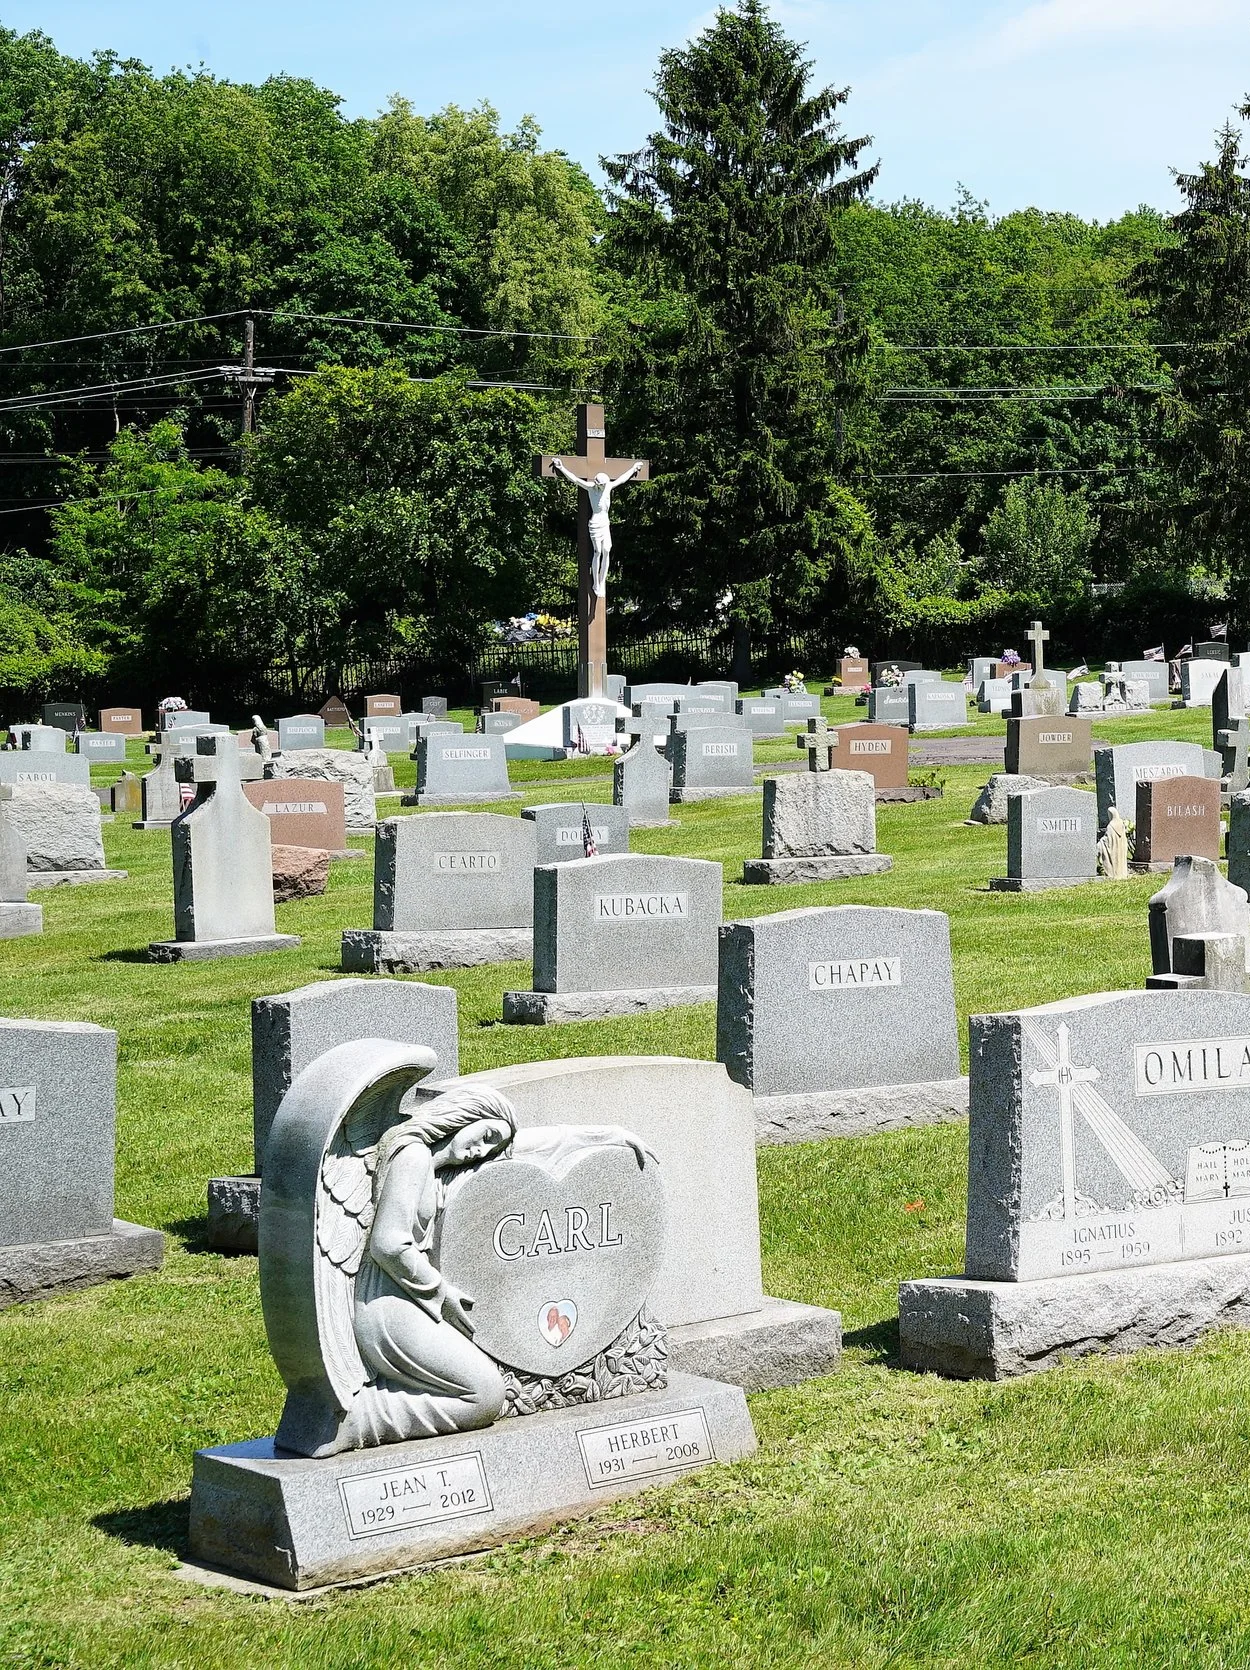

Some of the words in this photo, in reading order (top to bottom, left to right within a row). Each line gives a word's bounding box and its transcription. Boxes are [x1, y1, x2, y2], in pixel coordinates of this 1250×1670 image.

[444, 749, 489, 759] SELFINGER
[704, 744, 736, 754] BERISH
[854, 742, 887, 752] HYDEN
[18, 772, 54, 782] SABOL
[274, 803, 314, 813] LAZUR
[1041, 819, 1078, 832] SMITH
[438, 855, 497, 869] CEARTO
[599, 896, 684, 917] KUBACKA
[814, 961, 895, 986] CHAPAY
[1197, 1160, 1217, 1169] HAIL
[1195, 1173, 1220, 1182] MARY
[492, 1202, 623, 1261] CARL
[1073, 1222, 1136, 1244] IGNATIUS
[1214, 1229, 1243, 1247] 1892
[1061, 1249, 1091, 1266] 1895
[1121, 1241, 1150, 1259] 1959
[607, 1423, 681, 1454] HERBERT
[598, 1457, 626, 1476] 1931
[665, 1442, 701, 1462] 2008
[379, 1475, 428, 1502] JEAN
[437, 1470, 453, 1489] T.
[361, 1505, 396, 1526] 1929
[440, 1488, 476, 1509] 2012
